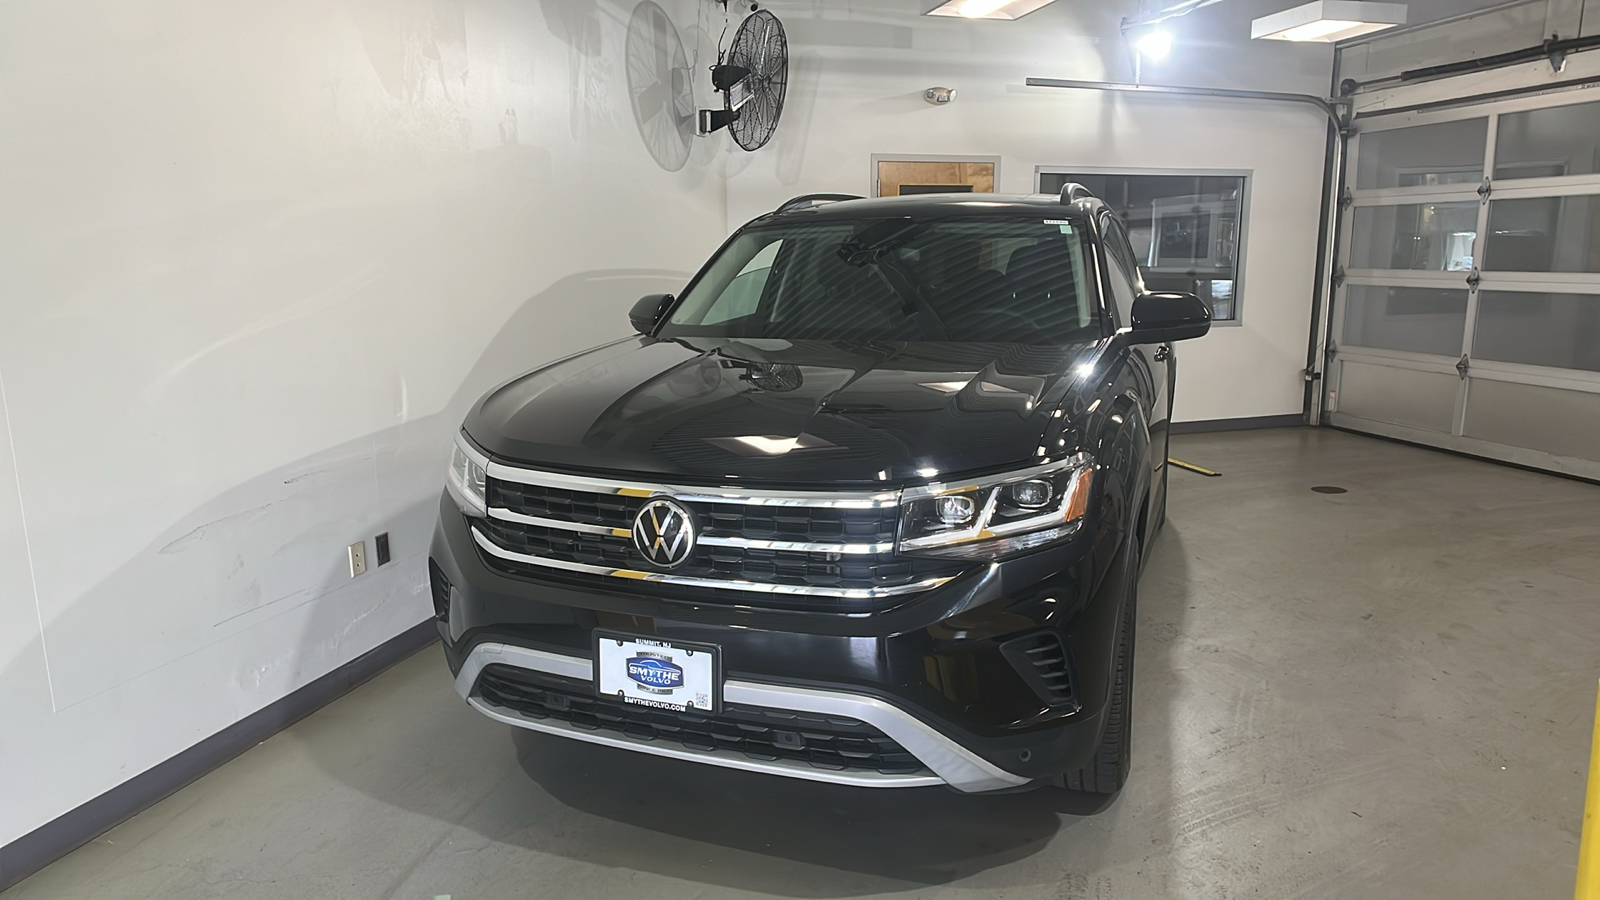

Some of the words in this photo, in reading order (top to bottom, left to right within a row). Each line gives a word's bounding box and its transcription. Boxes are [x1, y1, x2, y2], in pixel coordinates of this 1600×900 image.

[629, 666, 679, 681] SMYTHE
[641, 675, 671, 685] VOLVO
[624, 696, 686, 712] SMYTHEVOLVO.COM
